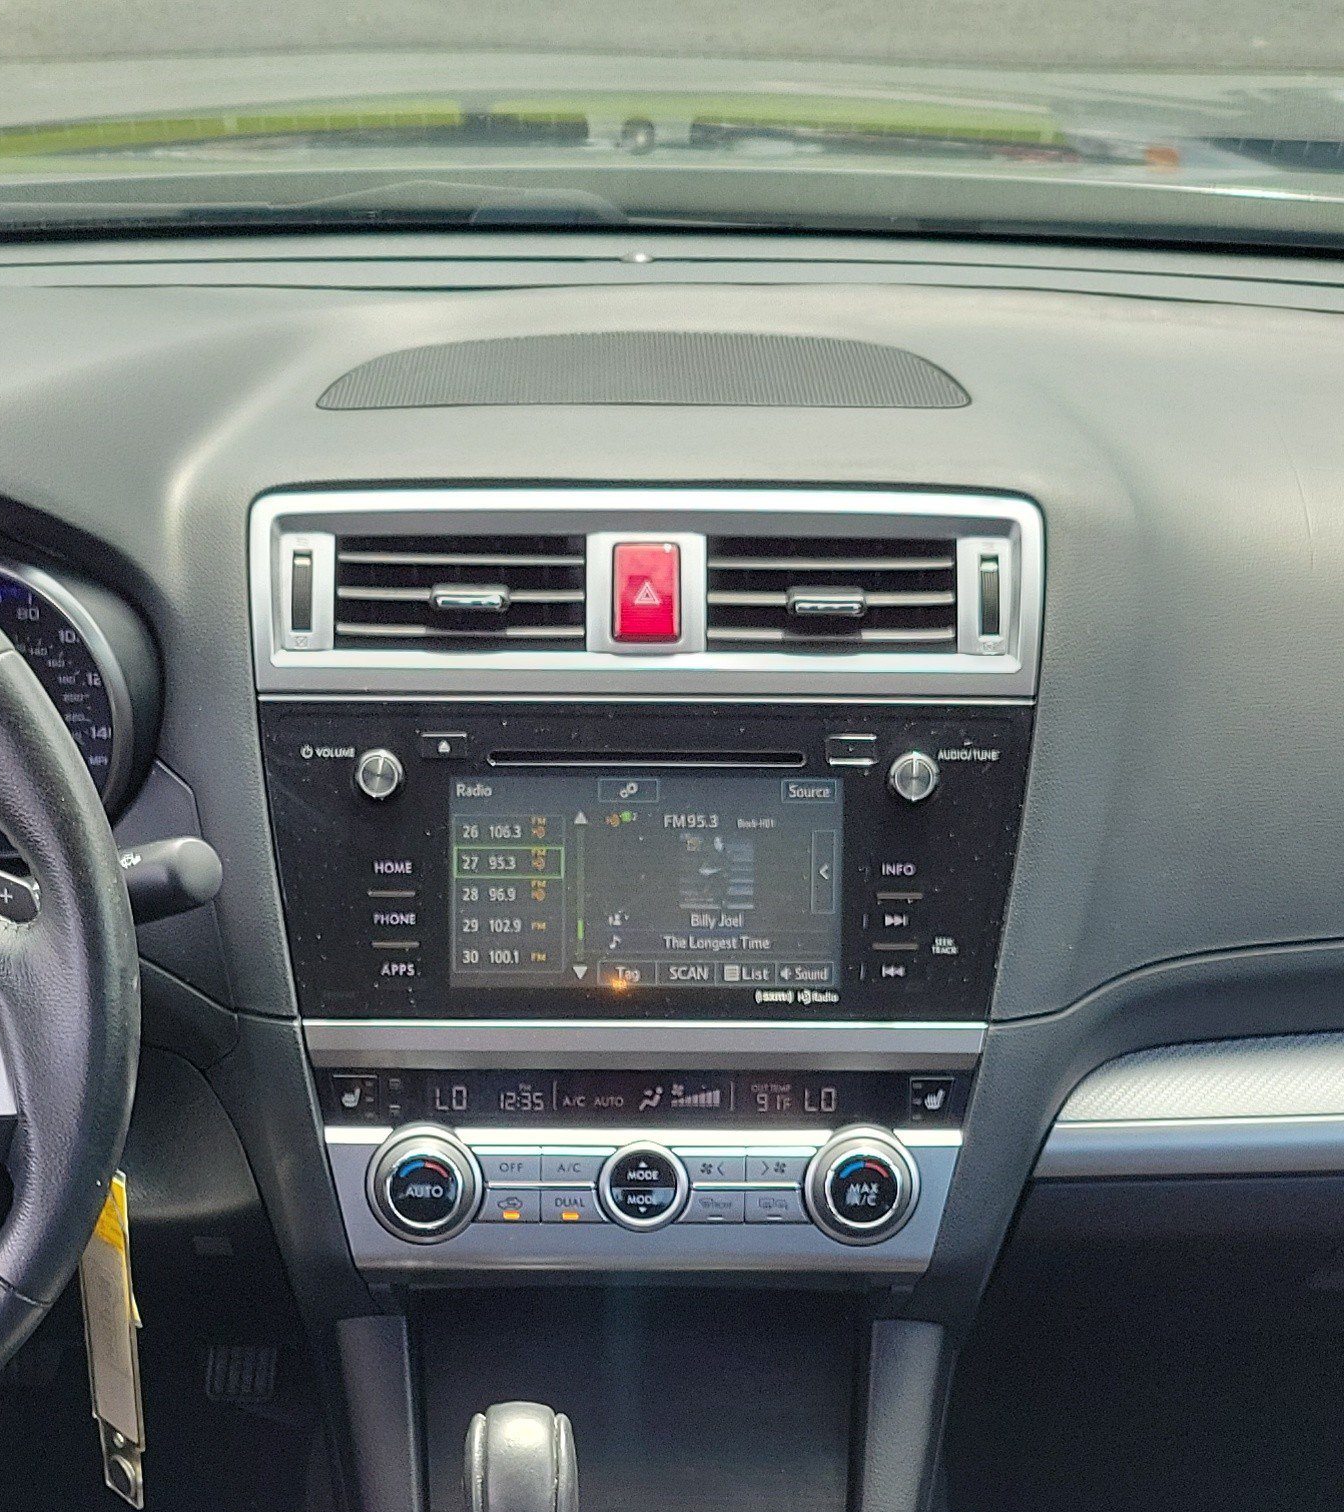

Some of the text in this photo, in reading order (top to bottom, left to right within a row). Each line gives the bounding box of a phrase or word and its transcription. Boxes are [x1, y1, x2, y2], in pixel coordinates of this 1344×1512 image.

[315, 747, 355, 758] VOLUME
[937, 749, 1000, 762] AUDIO/TUNE
[456, 783, 492, 798] Radio
[788, 784, 832, 799] Source
[462, 825, 479, 839] 26
[488, 825, 522, 839] 106.3
[373, 861, 413, 875] HOME
[462, 856, 479, 870] 27
[488, 856, 517, 870] 95.3
[881, 863, 916, 876] INFO
[462, 888, 479, 902] 28
[488, 888, 516, 902] 96.9
[373, 914, 417, 926] PHONE
[462, 919, 479, 933] 29
[488, 919, 522, 933] 102.9
[690, 912, 744, 930] Billy Joel
[663, 935, 771, 951] The Longest Time
[462, 951, 479, 964] 30
[488, 951, 520, 964] 100.1
[380, 963, 416, 977] APPS
[615, 966, 641, 983] Tag
[669, 966, 709, 981] SCAN
[742, 967, 770, 981] List
[794, 967, 830, 981] Sound
[499, 1092, 545, 1111] 12:35
[562, 1095, 624, 1108] A/C AUTO
[499, 1162, 524, 1174] OFF
[556, 1162, 583, 1174] A/C
[626, 1170, 659, 1182] MODE
[405, 1185, 445, 1199] AUTO
[848, 1181, 880, 1194] MAX
[554, 1198, 586, 1209] DUAL
